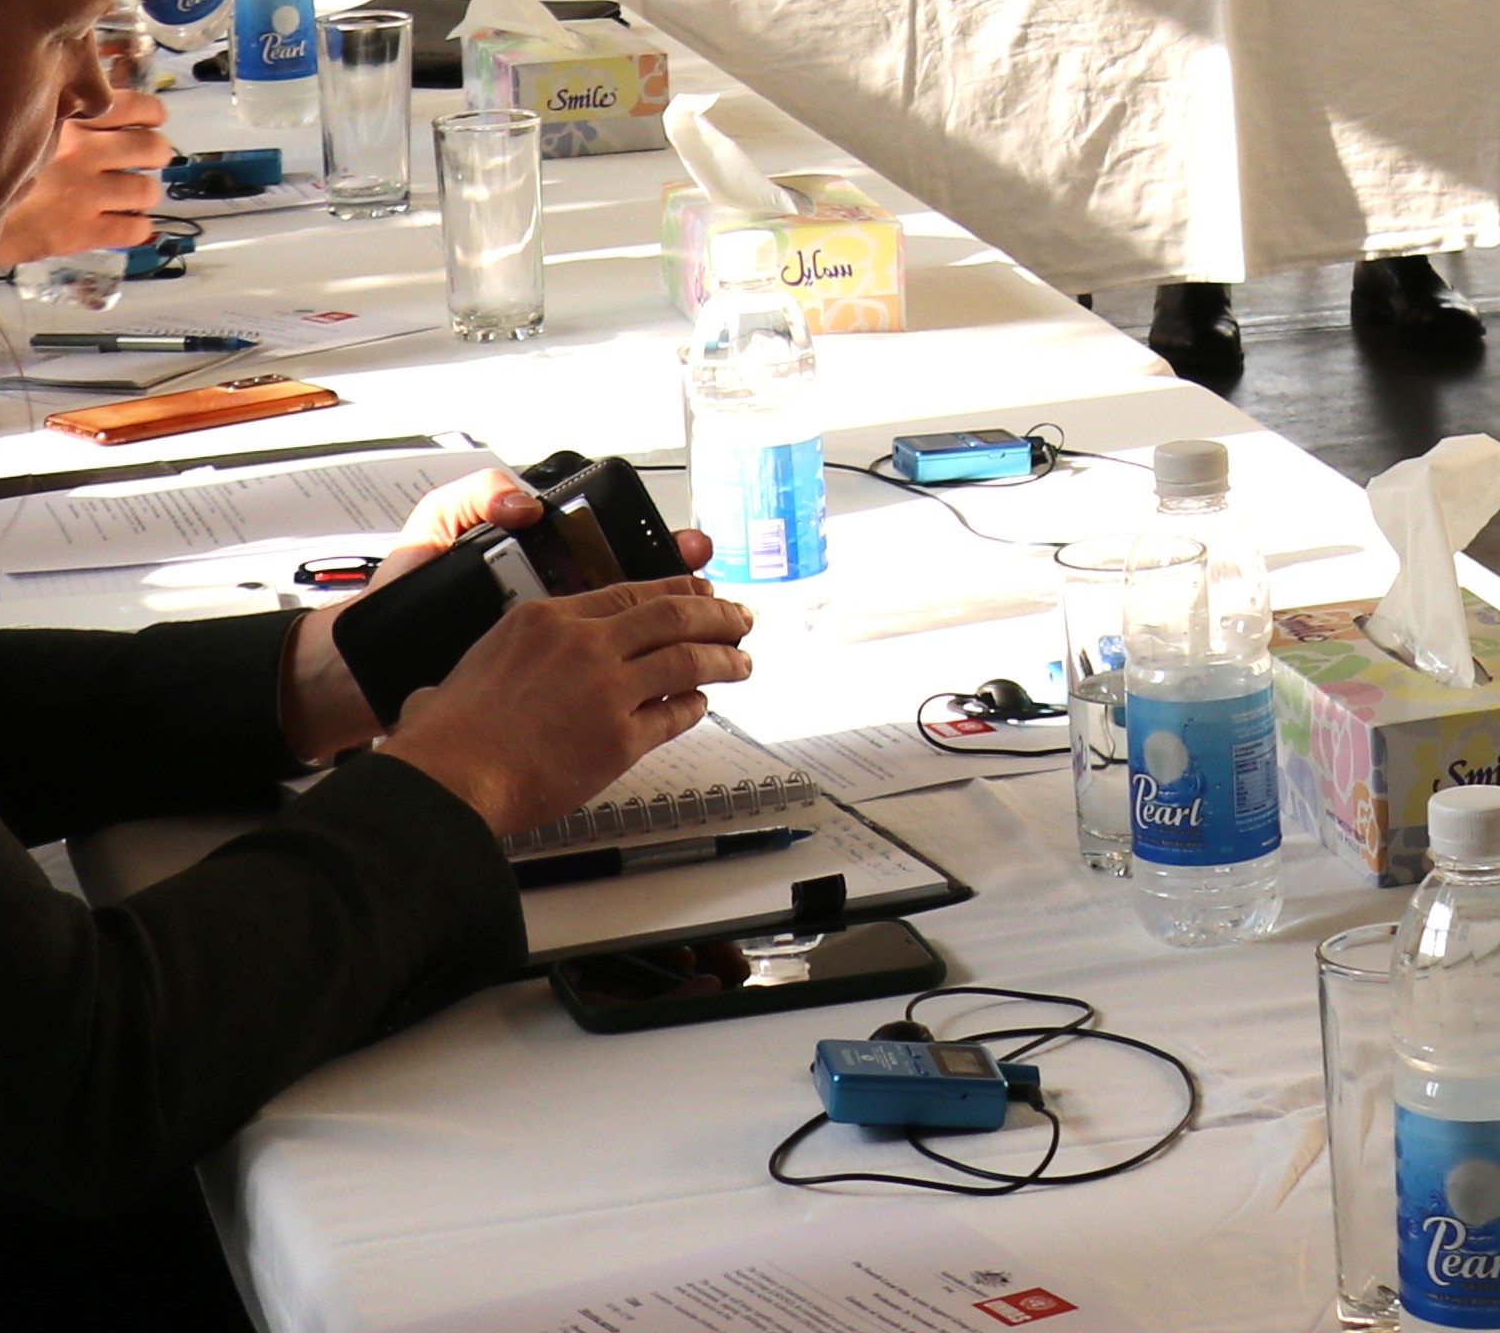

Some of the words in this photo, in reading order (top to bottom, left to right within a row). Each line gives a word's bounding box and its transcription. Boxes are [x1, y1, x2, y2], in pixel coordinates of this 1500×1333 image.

[259, 32, 306, 65] Pearl
[547, 85, 617, 111] Smile
[781, 249, 853, 287] سمايل
[1132, 773, 1204, 830] Pearl
